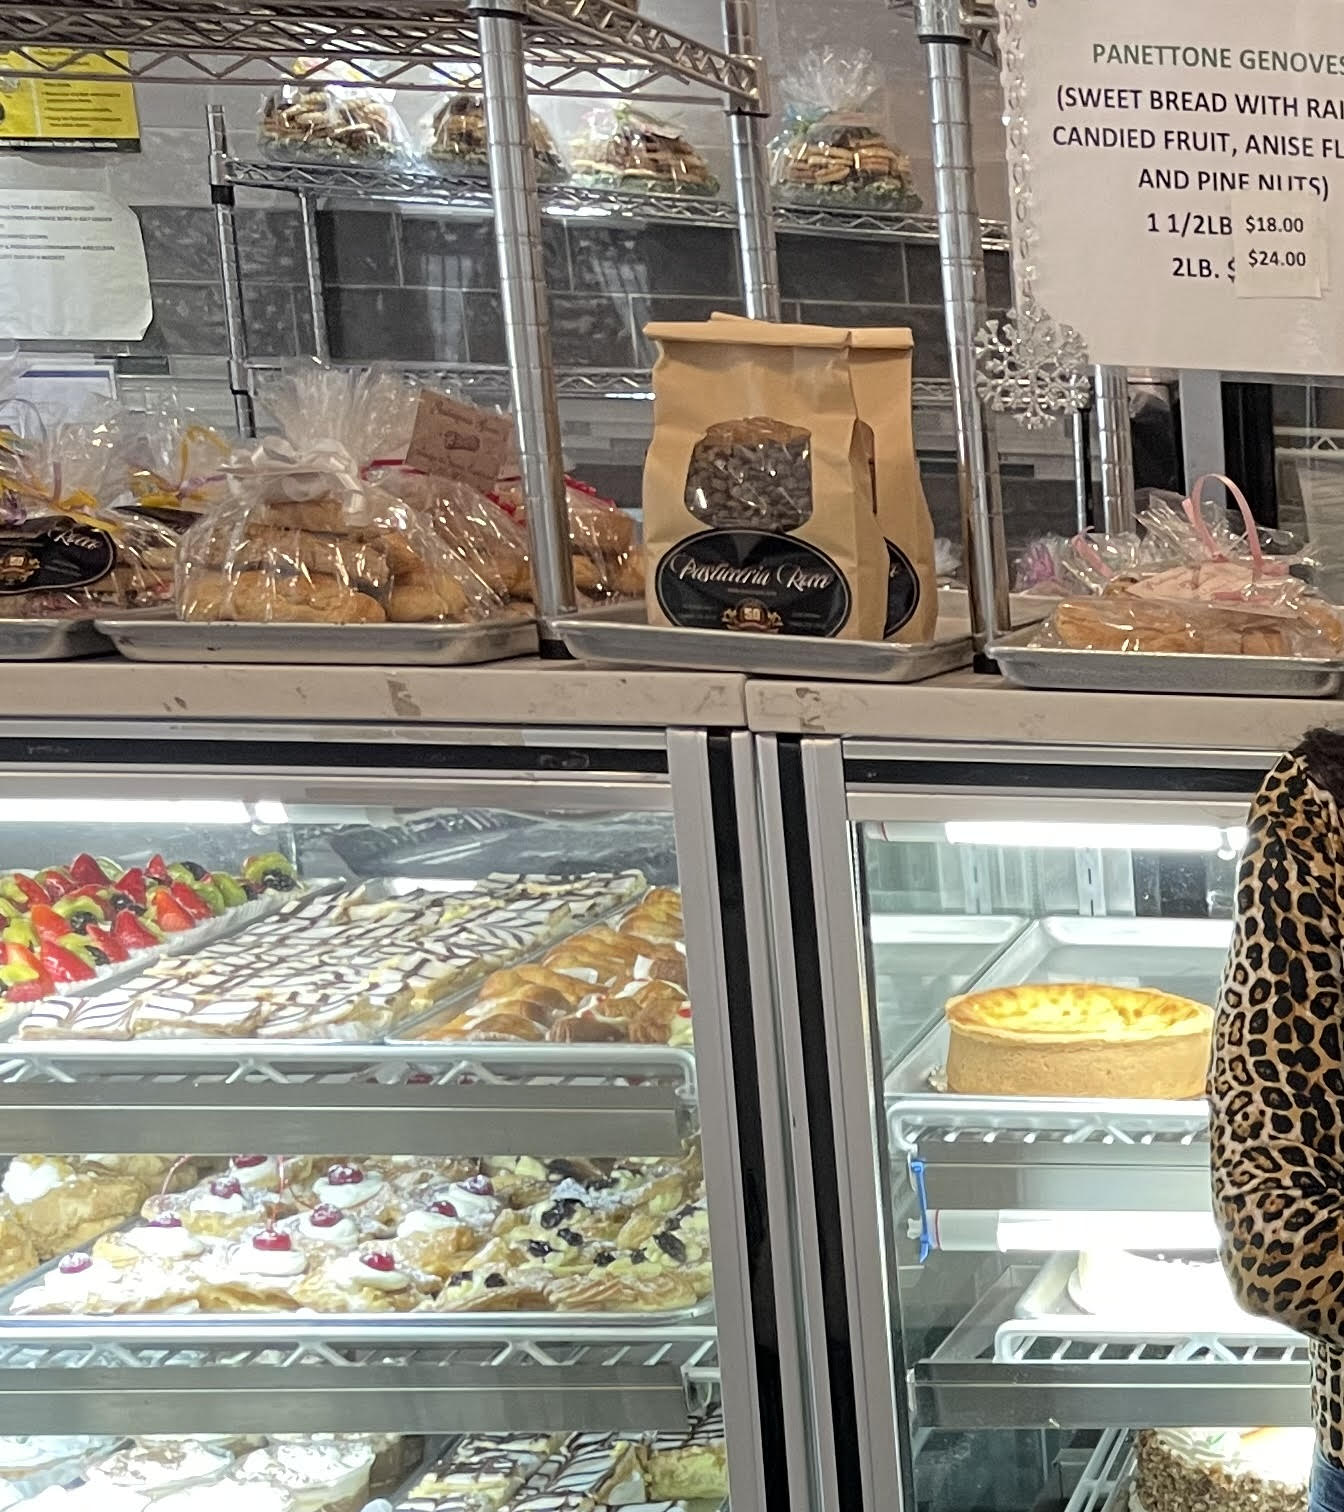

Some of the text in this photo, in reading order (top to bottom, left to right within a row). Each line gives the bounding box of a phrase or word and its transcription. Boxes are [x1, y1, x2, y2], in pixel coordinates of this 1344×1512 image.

[1093, 43, 1231, 68] PANETTONE
[1057, 85, 1142, 111] (SWEET
[1150, 90, 1227, 112] BREAD
[1235, 93, 1298, 117] WITH
[1053, 126, 1155, 148] CANDIED
[1164, 130, 1237, 157] FRUIT,
[1245, 134, 1314, 157] ANISE
[1138, 168, 1189, 189] AND
[1147, 213, 1160, 232] 1
[1246, 215, 1304, 234] $18.00
[1172, 257, 1219, 278] 2LB.
[1248, 248, 1306, 268] $24.00
